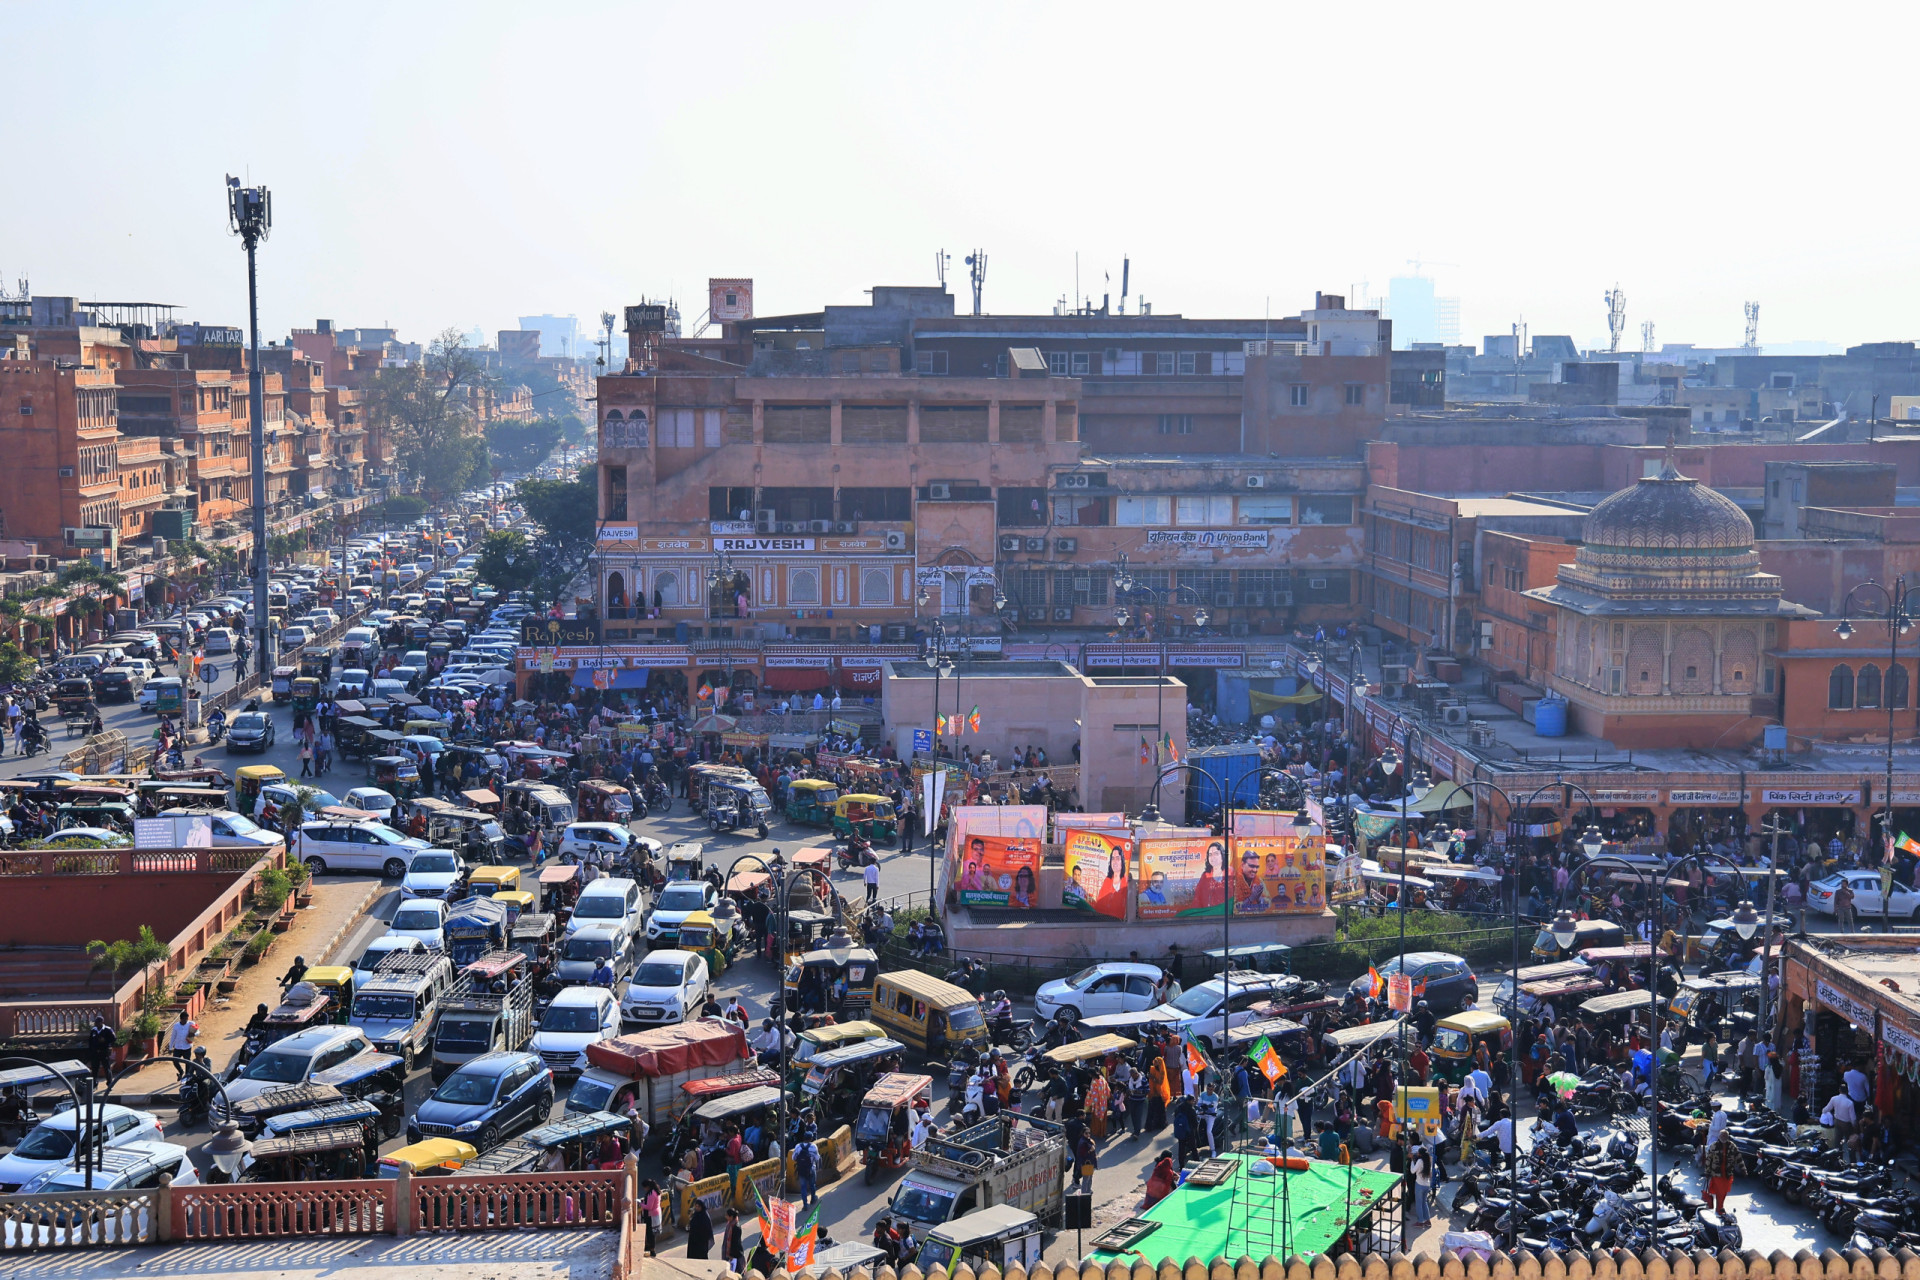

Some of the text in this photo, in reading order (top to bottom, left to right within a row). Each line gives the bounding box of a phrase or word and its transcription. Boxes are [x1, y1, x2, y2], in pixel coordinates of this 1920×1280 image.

[203, 330, 224, 343] AARI
[1149, 531, 1197, 544] यूनियन बैंक
[1217, 532, 1265, 542] Union Bank
[657, 540, 690, 549] राजवेश
[723, 539, 805, 550] RAJVESH
[839, 539, 868, 548] राजवेश
[525, 625, 595, 646] Rajvesh
[1769, 791, 1787, 801] पिंक
[1788, 791, 1812, 801] सिटी
